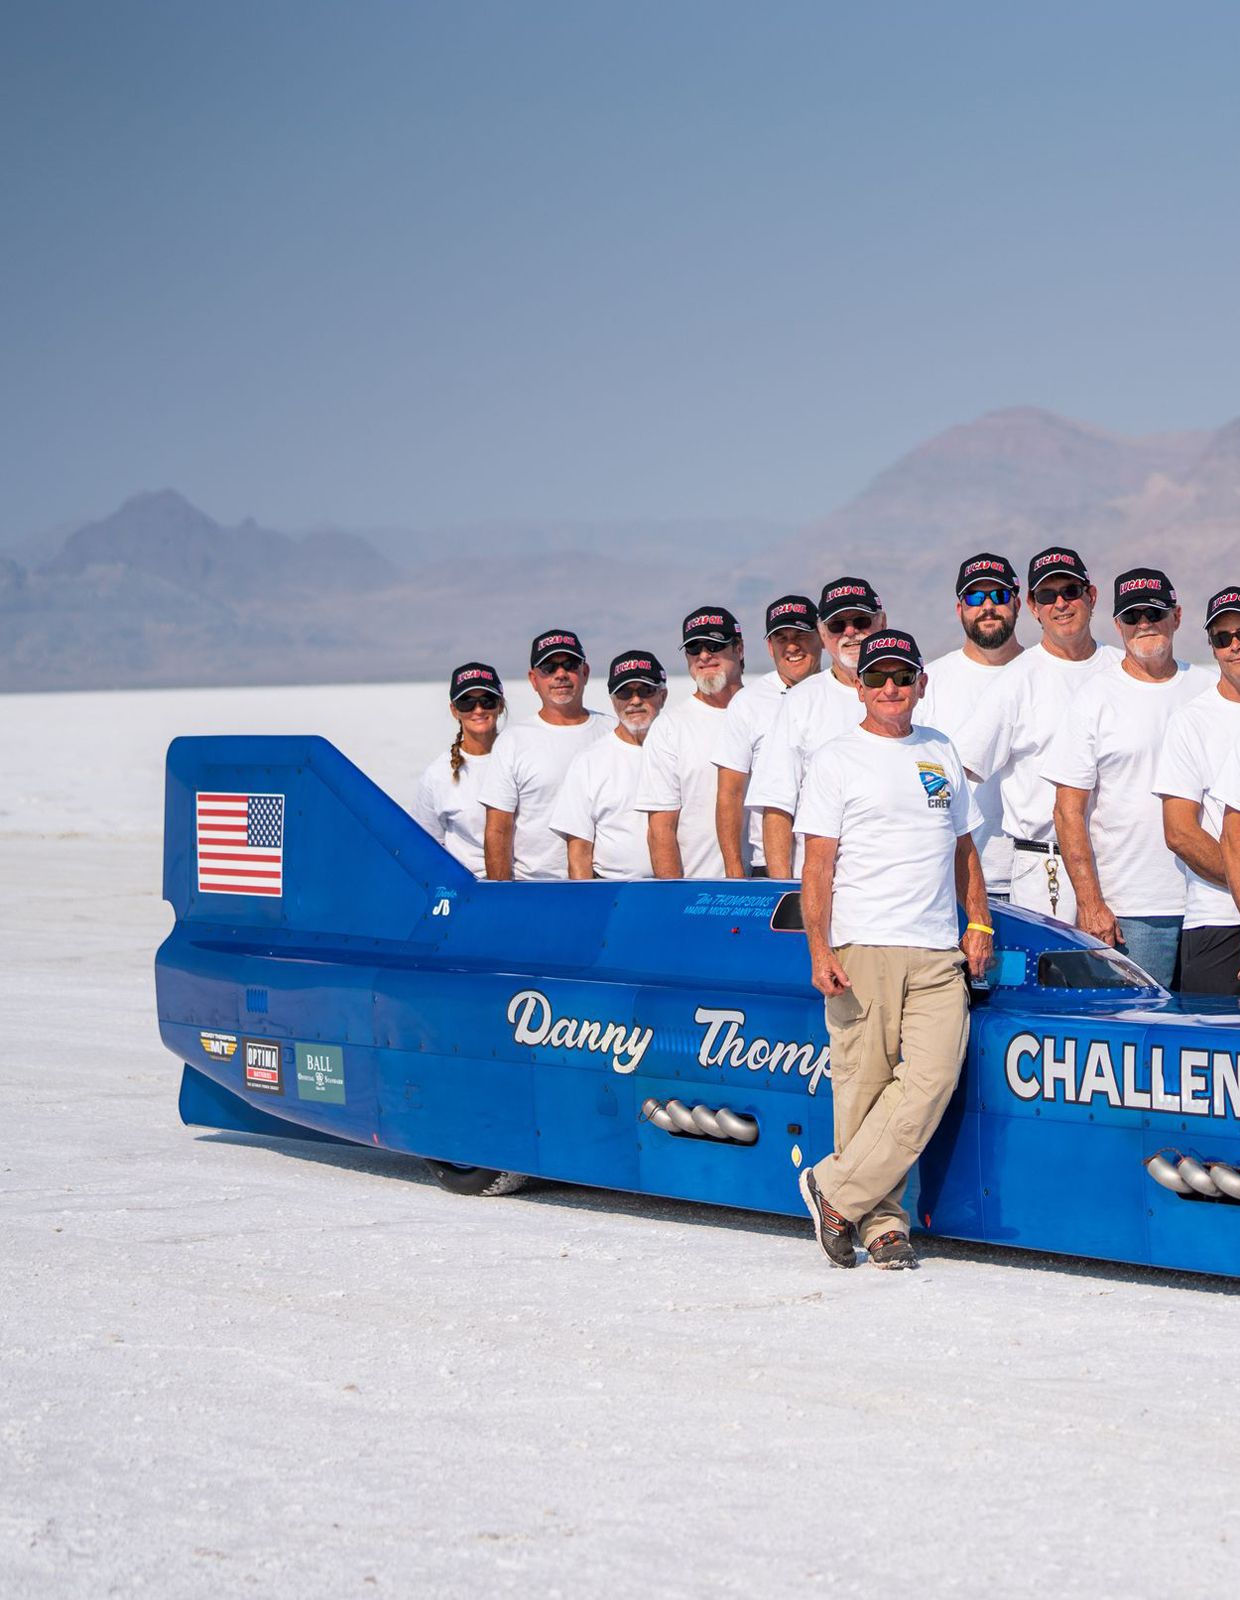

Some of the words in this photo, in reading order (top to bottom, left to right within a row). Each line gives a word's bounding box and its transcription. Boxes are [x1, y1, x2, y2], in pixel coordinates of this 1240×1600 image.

[964, 560, 990, 576] LUCAS
[990, 562, 1004, 573] OIL
[1034, 554, 1061, 571] LUCAS
[1061, 553, 1075, 566] OIL
[826, 587, 851, 603] LUCAS
[851, 586, 866, 597] OIL
[1119, 578, 1146, 595] LUCAS
[1146, 579, 1161, 591] OIL
[1212, 593, 1238, 611] LUCAS
[770, 603, 793, 620] LUCAS
[793, 603, 807, 614] OIL
[684, 614, 709, 632] LUCAS
[709, 615, 723, 626] OIL
[538, 636, 561, 651] LUCAS
[561, 636, 576, 647] OIL
[866, 638, 896, 654] LUCAS
[896, 638, 911, 652] OIL
[614, 661, 636, 677] LUCAS
[636, 660, 651, 670] OIL
[457, 671, 479, 685] LUCAS
[479, 671, 494, 681] OIL
[507, 989, 654, 1074] Danny
[694, 1006, 834, 1096] Thomp
[248, 1047, 277, 1069] OPTIMA
[306, 1054, 333, 1073] BALL
